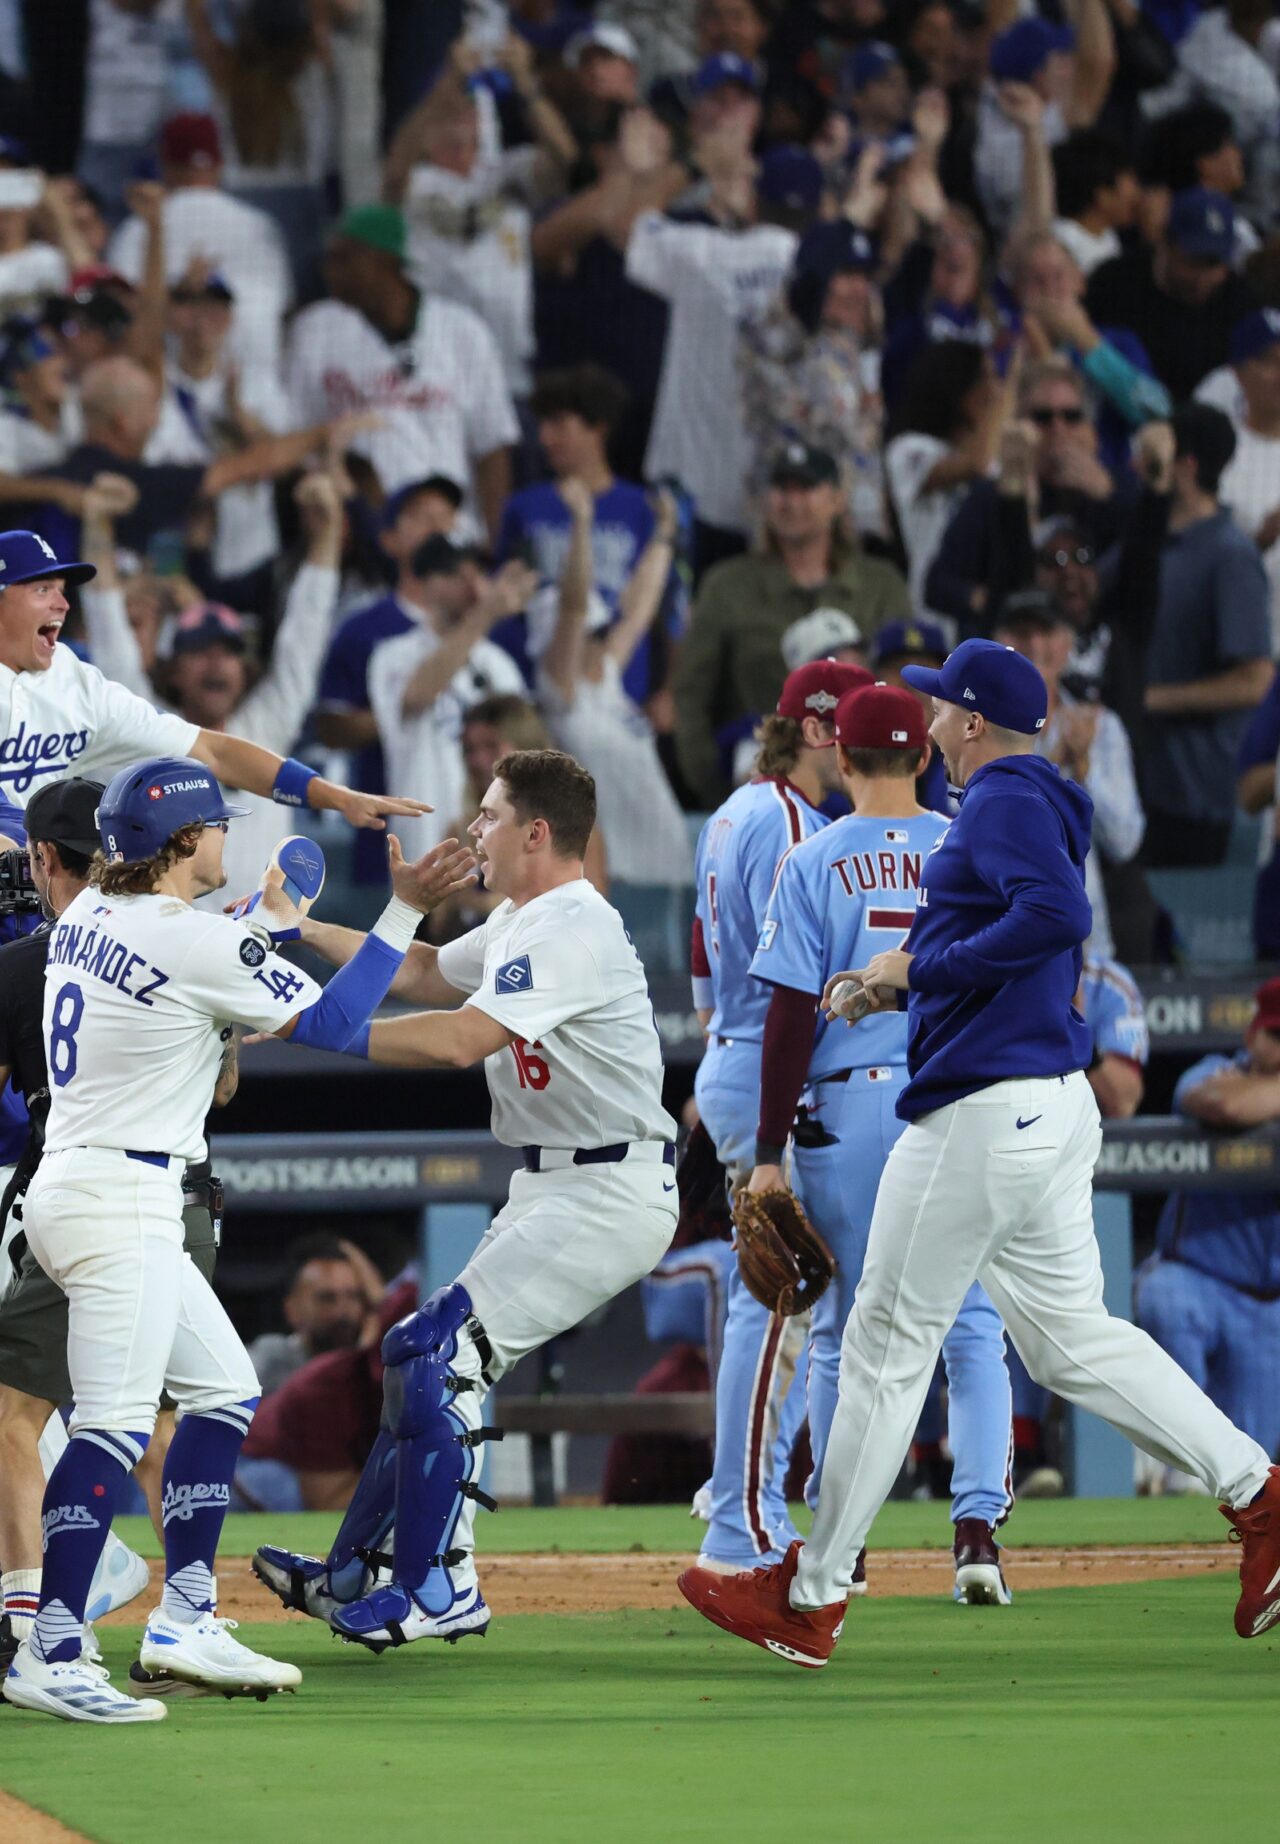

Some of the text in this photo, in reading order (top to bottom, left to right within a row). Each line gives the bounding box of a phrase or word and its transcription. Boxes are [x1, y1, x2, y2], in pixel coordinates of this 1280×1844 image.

[163, 779, 210, 795] STRAUSS
[107, 834, 117, 851] 8
[830, 851, 922, 896] TURN
[47, 923, 170, 1006] ERNÁNDEZ
[252, 968, 305, 1004] LA
[50, 981, 85, 1088] 8
[508, 1036, 552, 1091] 16
[161, 1480, 230, 1529] dgers
